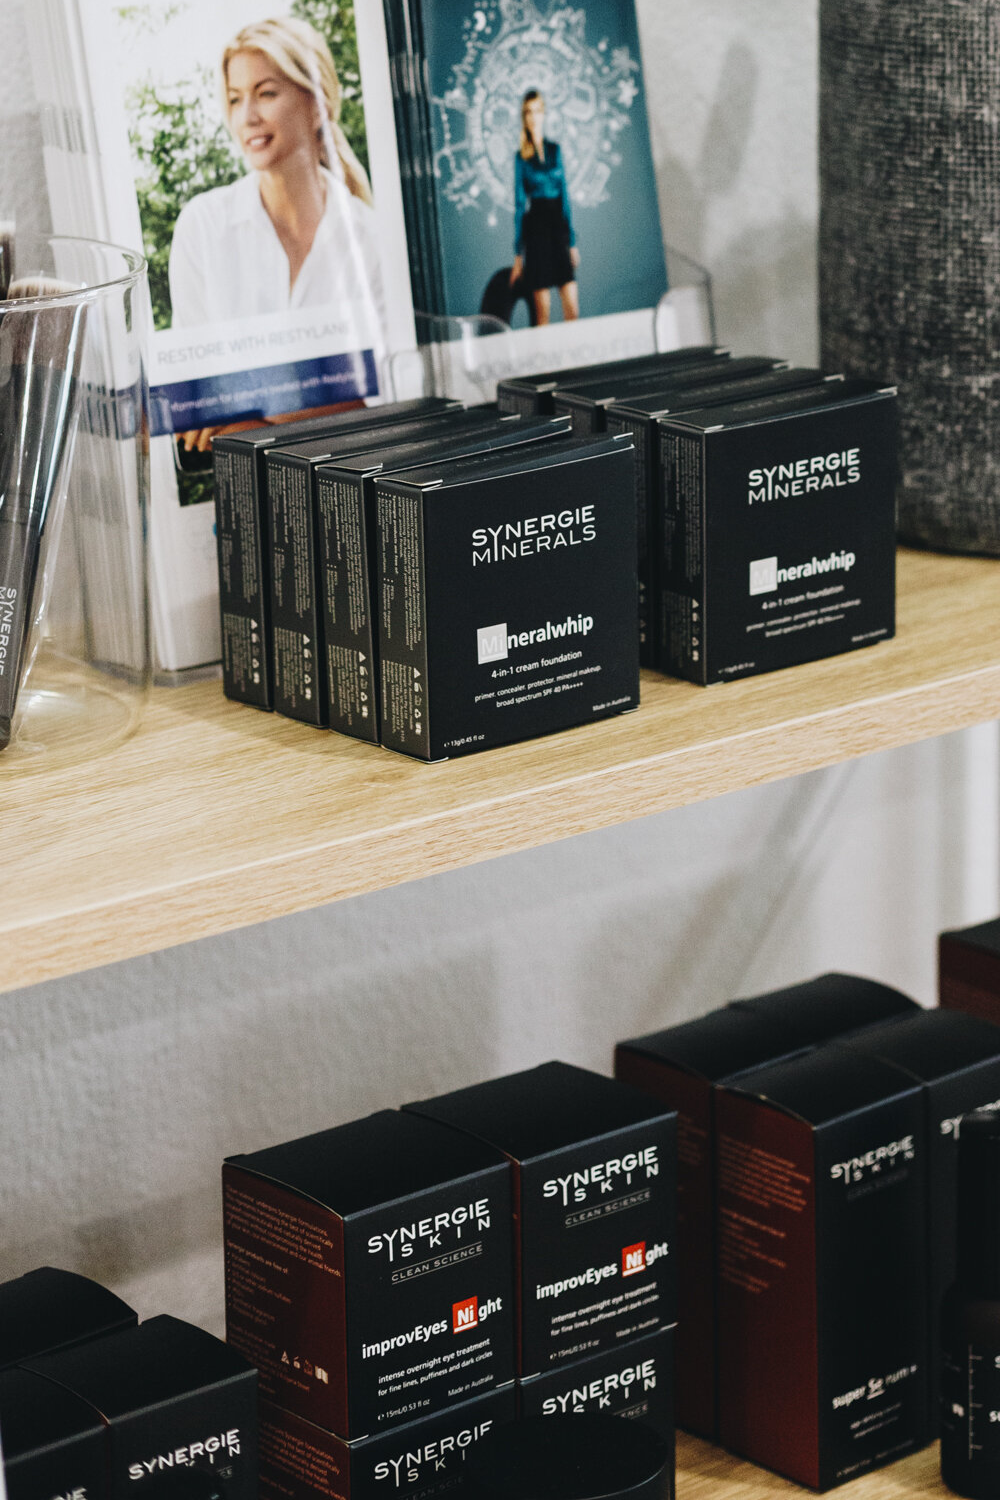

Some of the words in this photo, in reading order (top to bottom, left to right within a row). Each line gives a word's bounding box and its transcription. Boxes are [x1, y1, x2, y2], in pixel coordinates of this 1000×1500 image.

[157, 342, 226, 365] RESTORE
[228, 333, 266, 354] WITH
[268, 321, 348, 346] RESTYLAN
[749, 448, 860, 500] SYNERGIE
[749, 467, 860, 505] MINERALS
[472, 505, 596, 561] SYNERGIE
[472, 525, 597, 566] MINERALS
[752, 550, 856, 587] Mineralwhip
[480, 614, 593, 658] Mineralwhip
[491, 666, 515, 679] 4-in-1
[515, 661, 540, 674] cream
[541, 650, 583, 668] foundation
[556, 671, 578, 682] mineral
[496, 697, 515, 708] broad
[515, 691, 543, 704] spectrum
[542, 687, 553, 698] SPF
[553, 685, 562, 694] 40
[543, 1146, 659, 1206] SYNERGIE
[831, 1135, 913, 1185] SYNERGIE
[574, 1163, 659, 1202] SKIN
[565, 1209, 602, 1226] CLEAN
[604, 1191, 651, 1214] SCIENCE
[368, 1198, 490, 1262] SYNERGIE
[401, 1215, 491, 1257] SKIN
[391, 1263, 430, 1282] CLEAN
[434, 1244, 483, 1267] SCIENCE
[536, 1263, 618, 1300] improvEyes
[625, 1242, 669, 1271] Night
[551, 1311, 577, 1324] intense
[577, 1299, 611, 1316] overnight
[624, 1282, 658, 1300] treatment
[362, 1319, 448, 1360] improvEyes
[456, 1297, 502, 1327] Night
[378, 1371, 405, 1384] intense
[406, 1356, 441, 1376] overnight
[442, 1352, 455, 1364] eye
[456, 1338, 490, 1357] treatment
[378, 1387, 388, 1397] for
[388, 1383, 402, 1393] fine
[402, 1378, 419, 1389] lines,
[420, 1368, 448, 1384] puffiness
[448, 1362, 460, 1373] and
[461, 1357, 475, 1368] dark
[475, 1350, 493, 1363] circles
[447, 1386, 464, 1397] Made
[471, 1374, 494, 1388] Australia
[542, 1359, 656, 1415] SYNERGIE
[573, 1375, 656, 1412] SKIN
[832, 1385, 867, 1410] super
[128, 1429, 240, 1480] SYNERGIE
[407, 1449, 466, 1482] SKI
